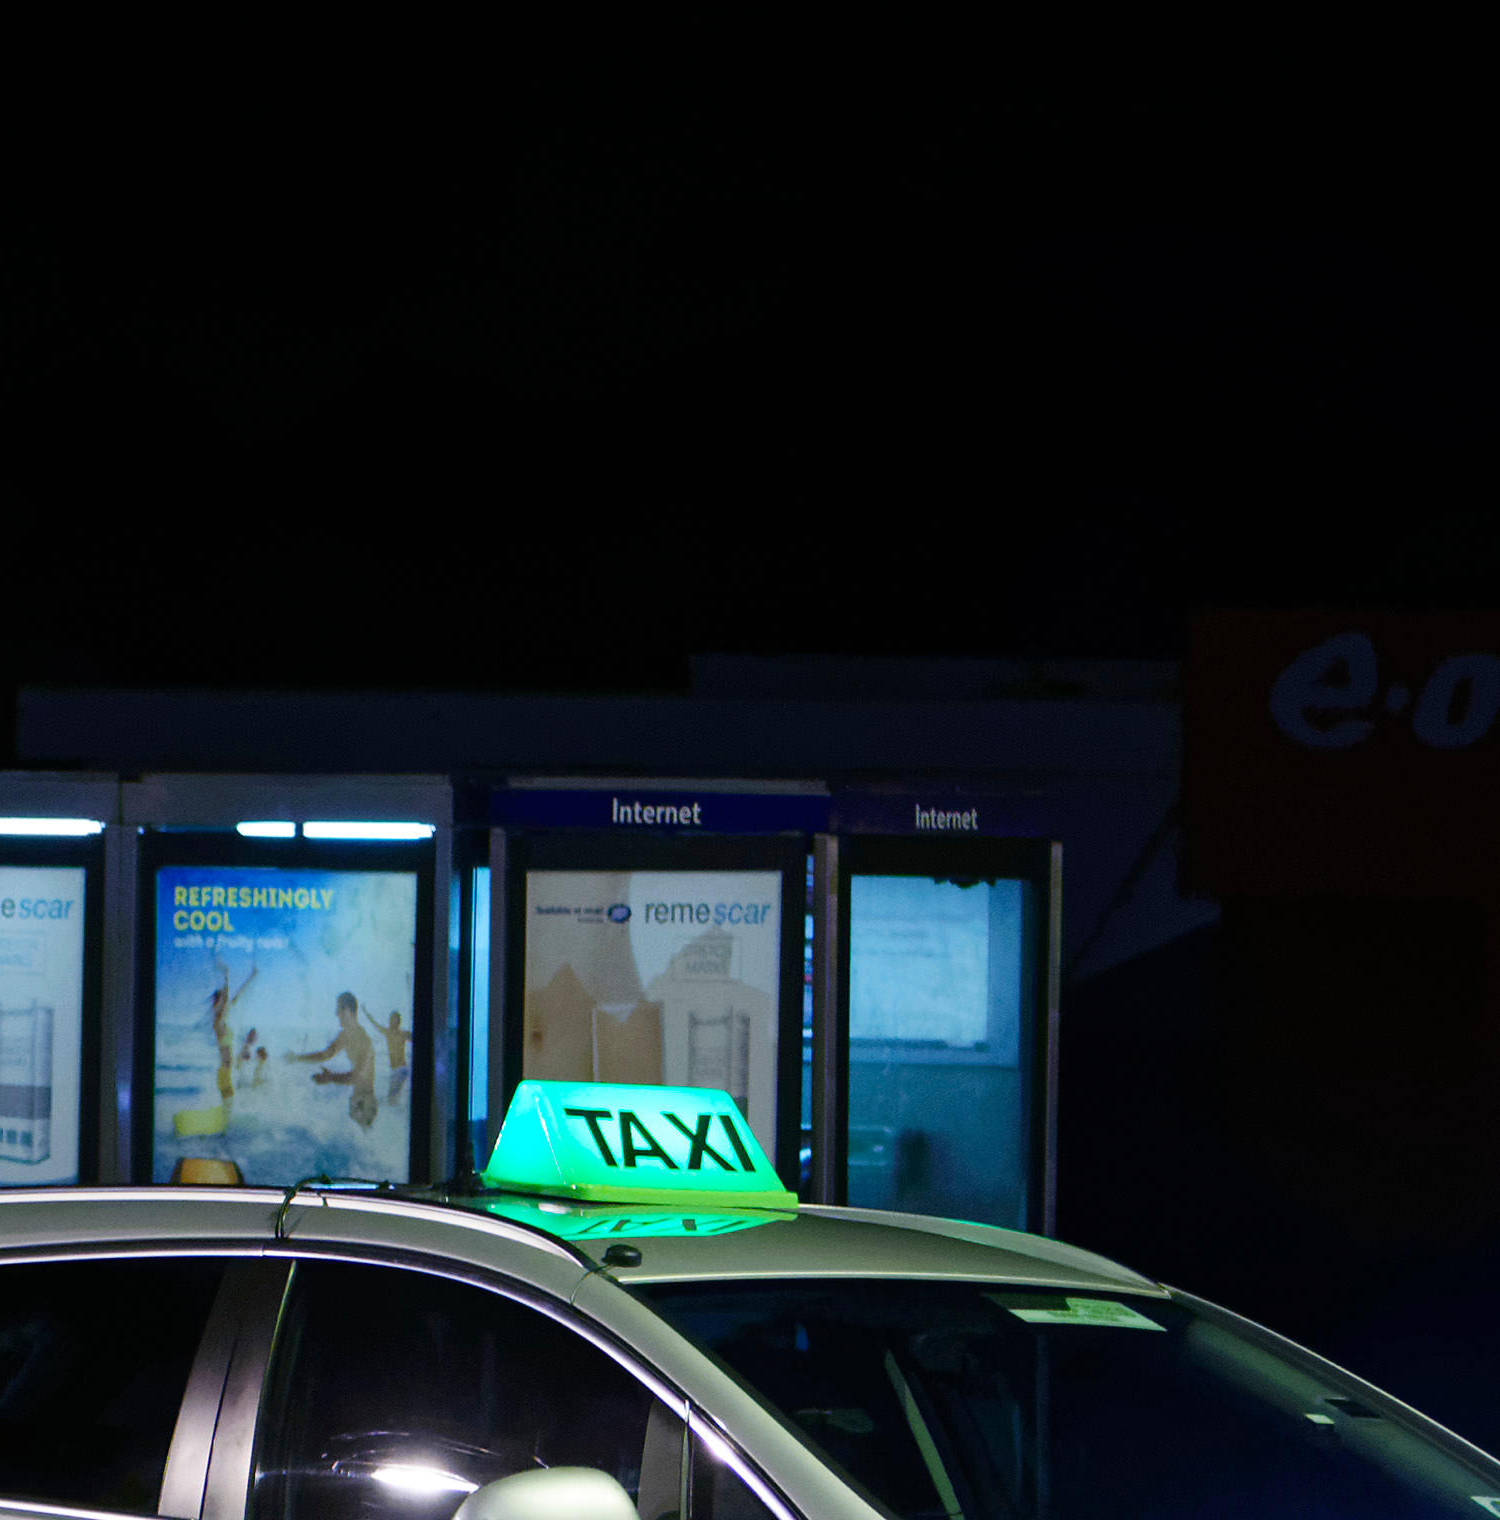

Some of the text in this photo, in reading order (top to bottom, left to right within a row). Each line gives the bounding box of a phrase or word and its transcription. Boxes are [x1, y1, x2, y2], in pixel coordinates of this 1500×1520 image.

[611, 797, 702, 826] Internet
[914, 804, 979, 830] Internet
[174, 885, 334, 909] REFRESHINGLY
[173, 909, 234, 932] COOL
[564, 1107, 757, 1173] TAXI
